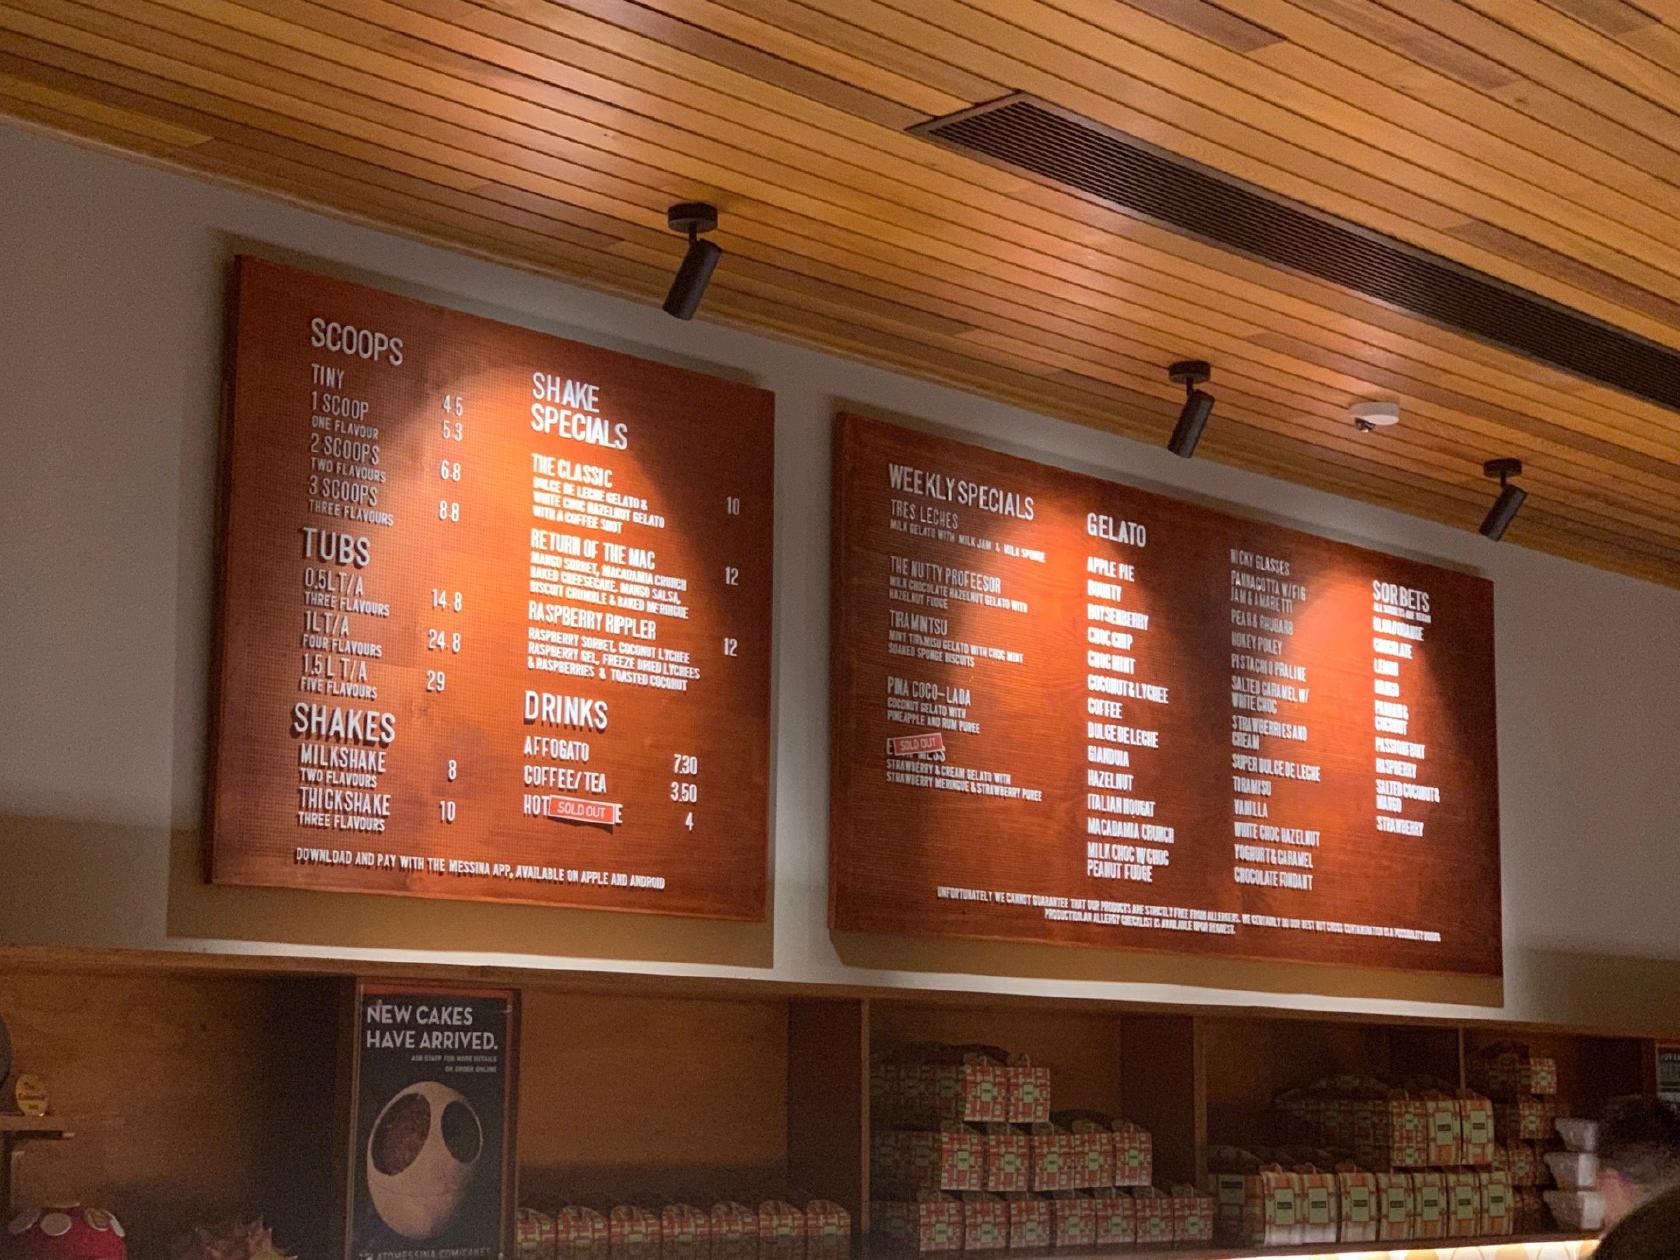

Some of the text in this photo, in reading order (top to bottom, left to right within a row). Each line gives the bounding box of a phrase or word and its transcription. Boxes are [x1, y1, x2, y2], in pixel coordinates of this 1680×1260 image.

[311, 318, 403, 366] SCOOPS
[311, 364, 344, 389] TINY
[532, 372, 599, 413] SHAKE
[323, 393, 369, 420] SCOOP
[312, 415, 379, 440] ONE FLAVOUR
[531, 403, 628, 450] SPECIALS
[311, 433, 380, 466] 2 SCOOPS
[311, 457, 386, 483] TWO FLAVOURS
[532, 453, 612, 488] THE CLASSIC
[309, 475, 377, 507] 3 SCOOPS
[889, 463, 1034, 521] WEEKLY SPECIALS
[309, 499, 394, 527] THREE FLAVOURS
[727, 496, 740, 516] 10
[891, 499, 958, 530] TRES LECHES
[1087, 512, 1146, 548] GELATO
[303, 527, 370, 567] TUBS
[530, 528, 656, 570] RETURN OF THE MAC
[725, 566, 739, 586] 12
[890, 556, 908, 575] THE
[912, 561, 943, 583] NUTTY
[1087, 556, 1135, 582] APPLE PIE
[1256, 555, 1290, 576] GLASSES
[305, 591, 390, 616] THREE FLAVOURS
[1372, 579, 1430, 613] SORBETS
[528, 601, 656, 640] RASPBERRY RIPPLER
[303, 634, 382, 657] FOUR FLAVOURS
[724, 638, 738, 657] 12
[301, 678, 377, 698] FIVE FLAVOURS
[427, 670, 445, 691] 29
[524, 690, 608, 730] DRINKS
[1088, 697, 1123, 719] COFFEE
[294, 703, 396, 743] SHAKES
[300, 743, 386, 772] MILKSHAKE
[523, 736, 589, 762] AFFOGATO
[900, 739, 920, 751] SOLD
[920, 738, 935, 749] OUT
[300, 768, 377, 788] TWO FLAVOURS
[448, 760, 457, 780] 8
[1088, 769, 1133, 791] HAZELNUT
[300, 786, 391, 815] THICKSHAKE
[440, 801, 456, 821] 10
[557, 801, 584, 817] SOLD
[586, 805, 606, 818] OUT
[299, 811, 385, 831] THREE FLAVOURS
[685, 812, 693, 831] 4
[1088, 817, 1174, 844] MACADAMIA CRUNCH
[296, 847, 352, 864] DOWNLOAD
[355, 852, 375, 866] AND
[377, 854, 396, 867] PAY
[399, 855, 424, 870] WITH
[428, 858, 445, 871] THE
[449, 860, 490, 875] MESSINA
[515, 865, 564, 881] AVAILABLE
[567, 869, 579, 881] ON
[581, 871, 608, 885] APPLE
[611, 873, 627, 886] AND
[629, 875, 665, 889] ANDROID
[1088, 859, 1152, 883] PEANUT FUDGE
[367, 1004, 473, 1026] NEW CAKES
[366, 1030, 498, 1050] HAVE ARRIVED.
